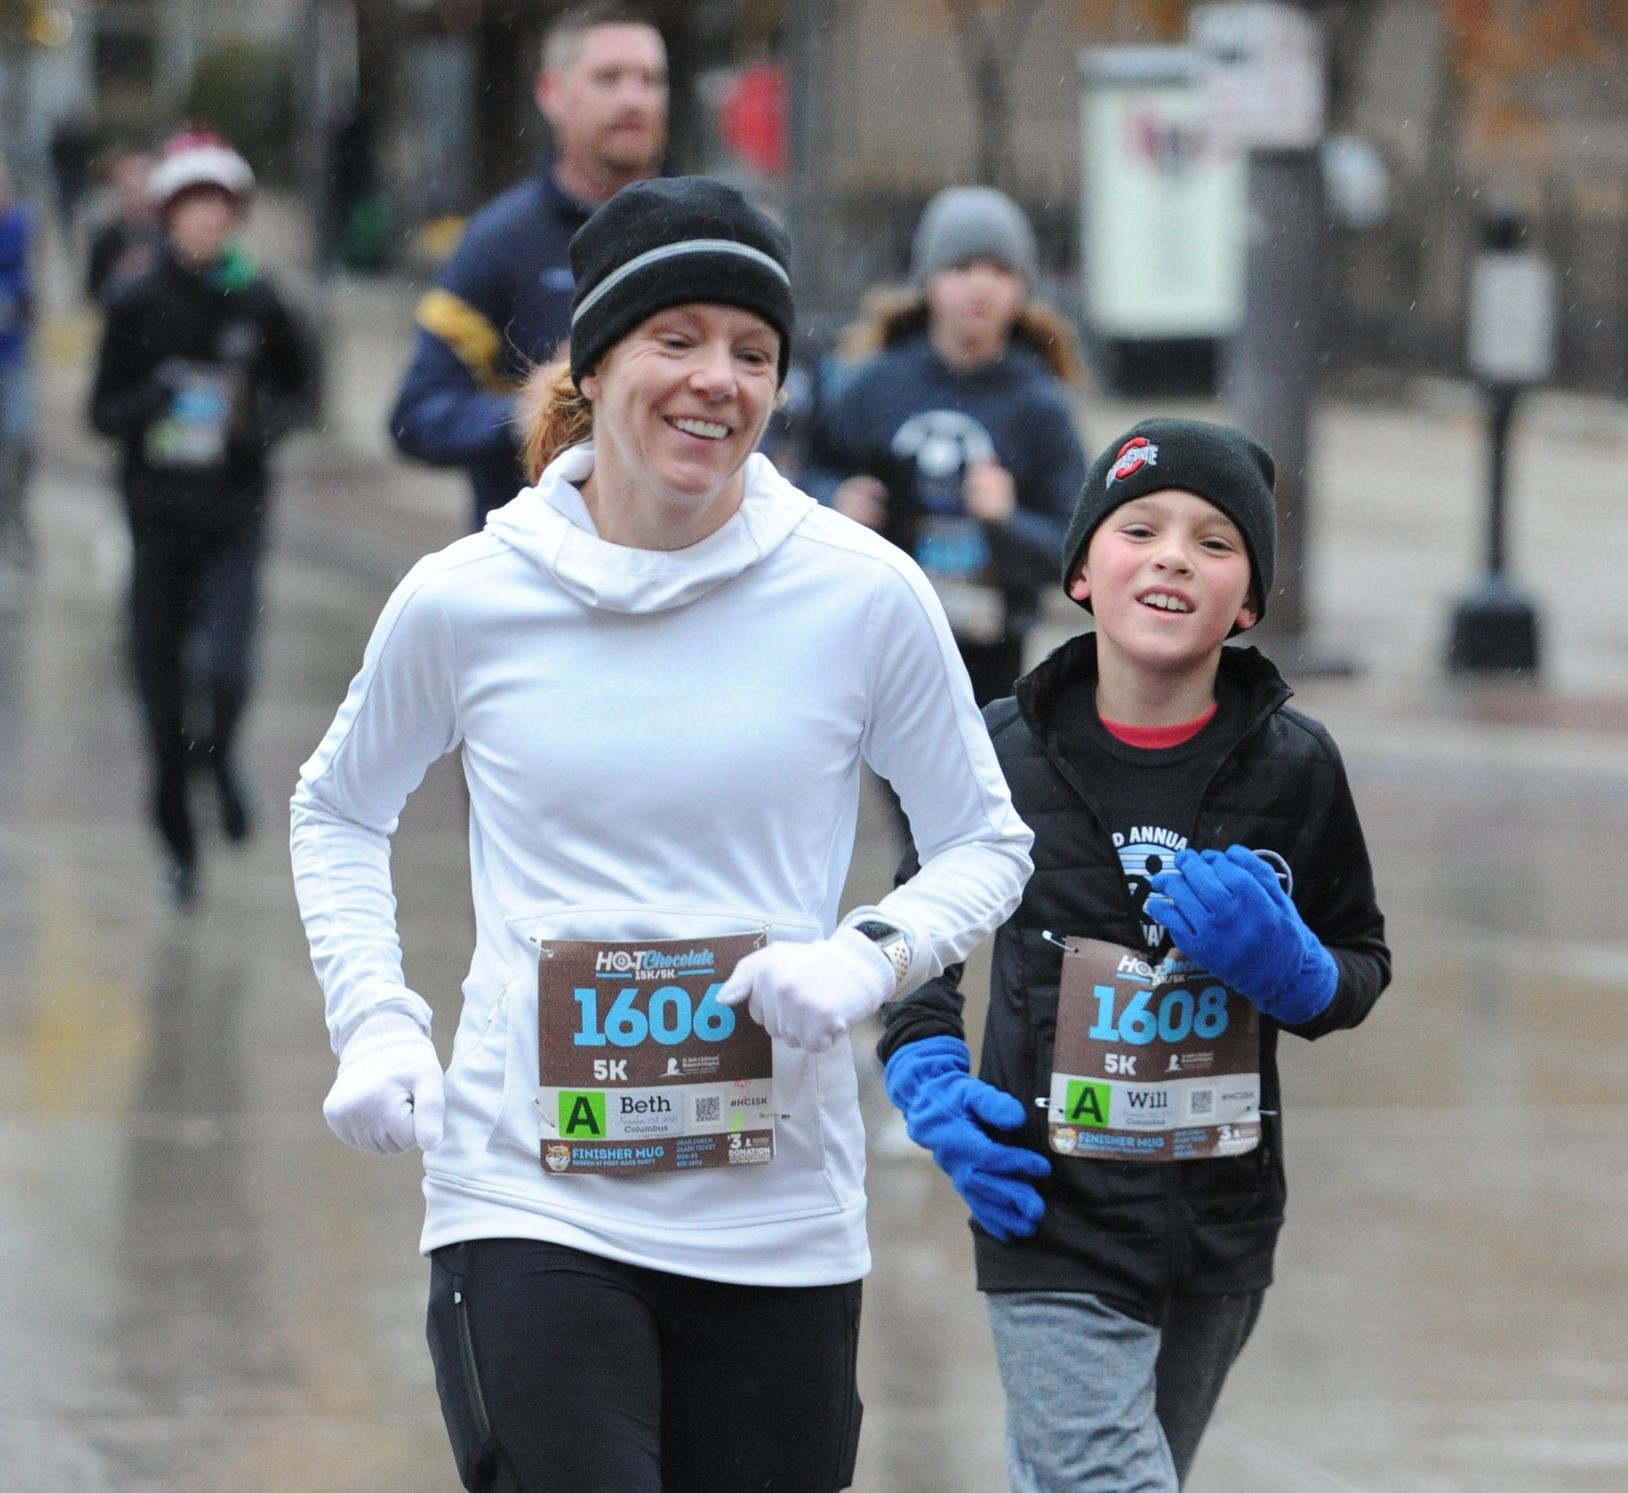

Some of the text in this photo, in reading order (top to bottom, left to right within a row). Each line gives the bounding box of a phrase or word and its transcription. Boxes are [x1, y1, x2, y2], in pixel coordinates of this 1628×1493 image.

[595, 948, 714, 971] HOT Chocolate
[634, 968, 676, 981] 15K/5K
[572, 983, 736, 1048] 1606
[1088, 984, 1230, 1046] 1608
[592, 1059, 629, 1081] 5K
[1104, 1053, 1138, 1076] 5K
[620, 1095, 672, 1114] Beth
[730, 1097, 769, 1107] #HC15K
[1071, 1086, 1104, 1123] A
[1126, 1091, 1168, 1109] Will
[565, 1096, 601, 1136] A
[624, 1124, 669, 1134] Columbus
[1077, 1132, 1136, 1148] FINISHER
[1136, 1136, 1165, 1149] MUG
[572, 1146, 665, 1160] FINISHER MUG
[728, 1146, 771, 1157] DONATION
